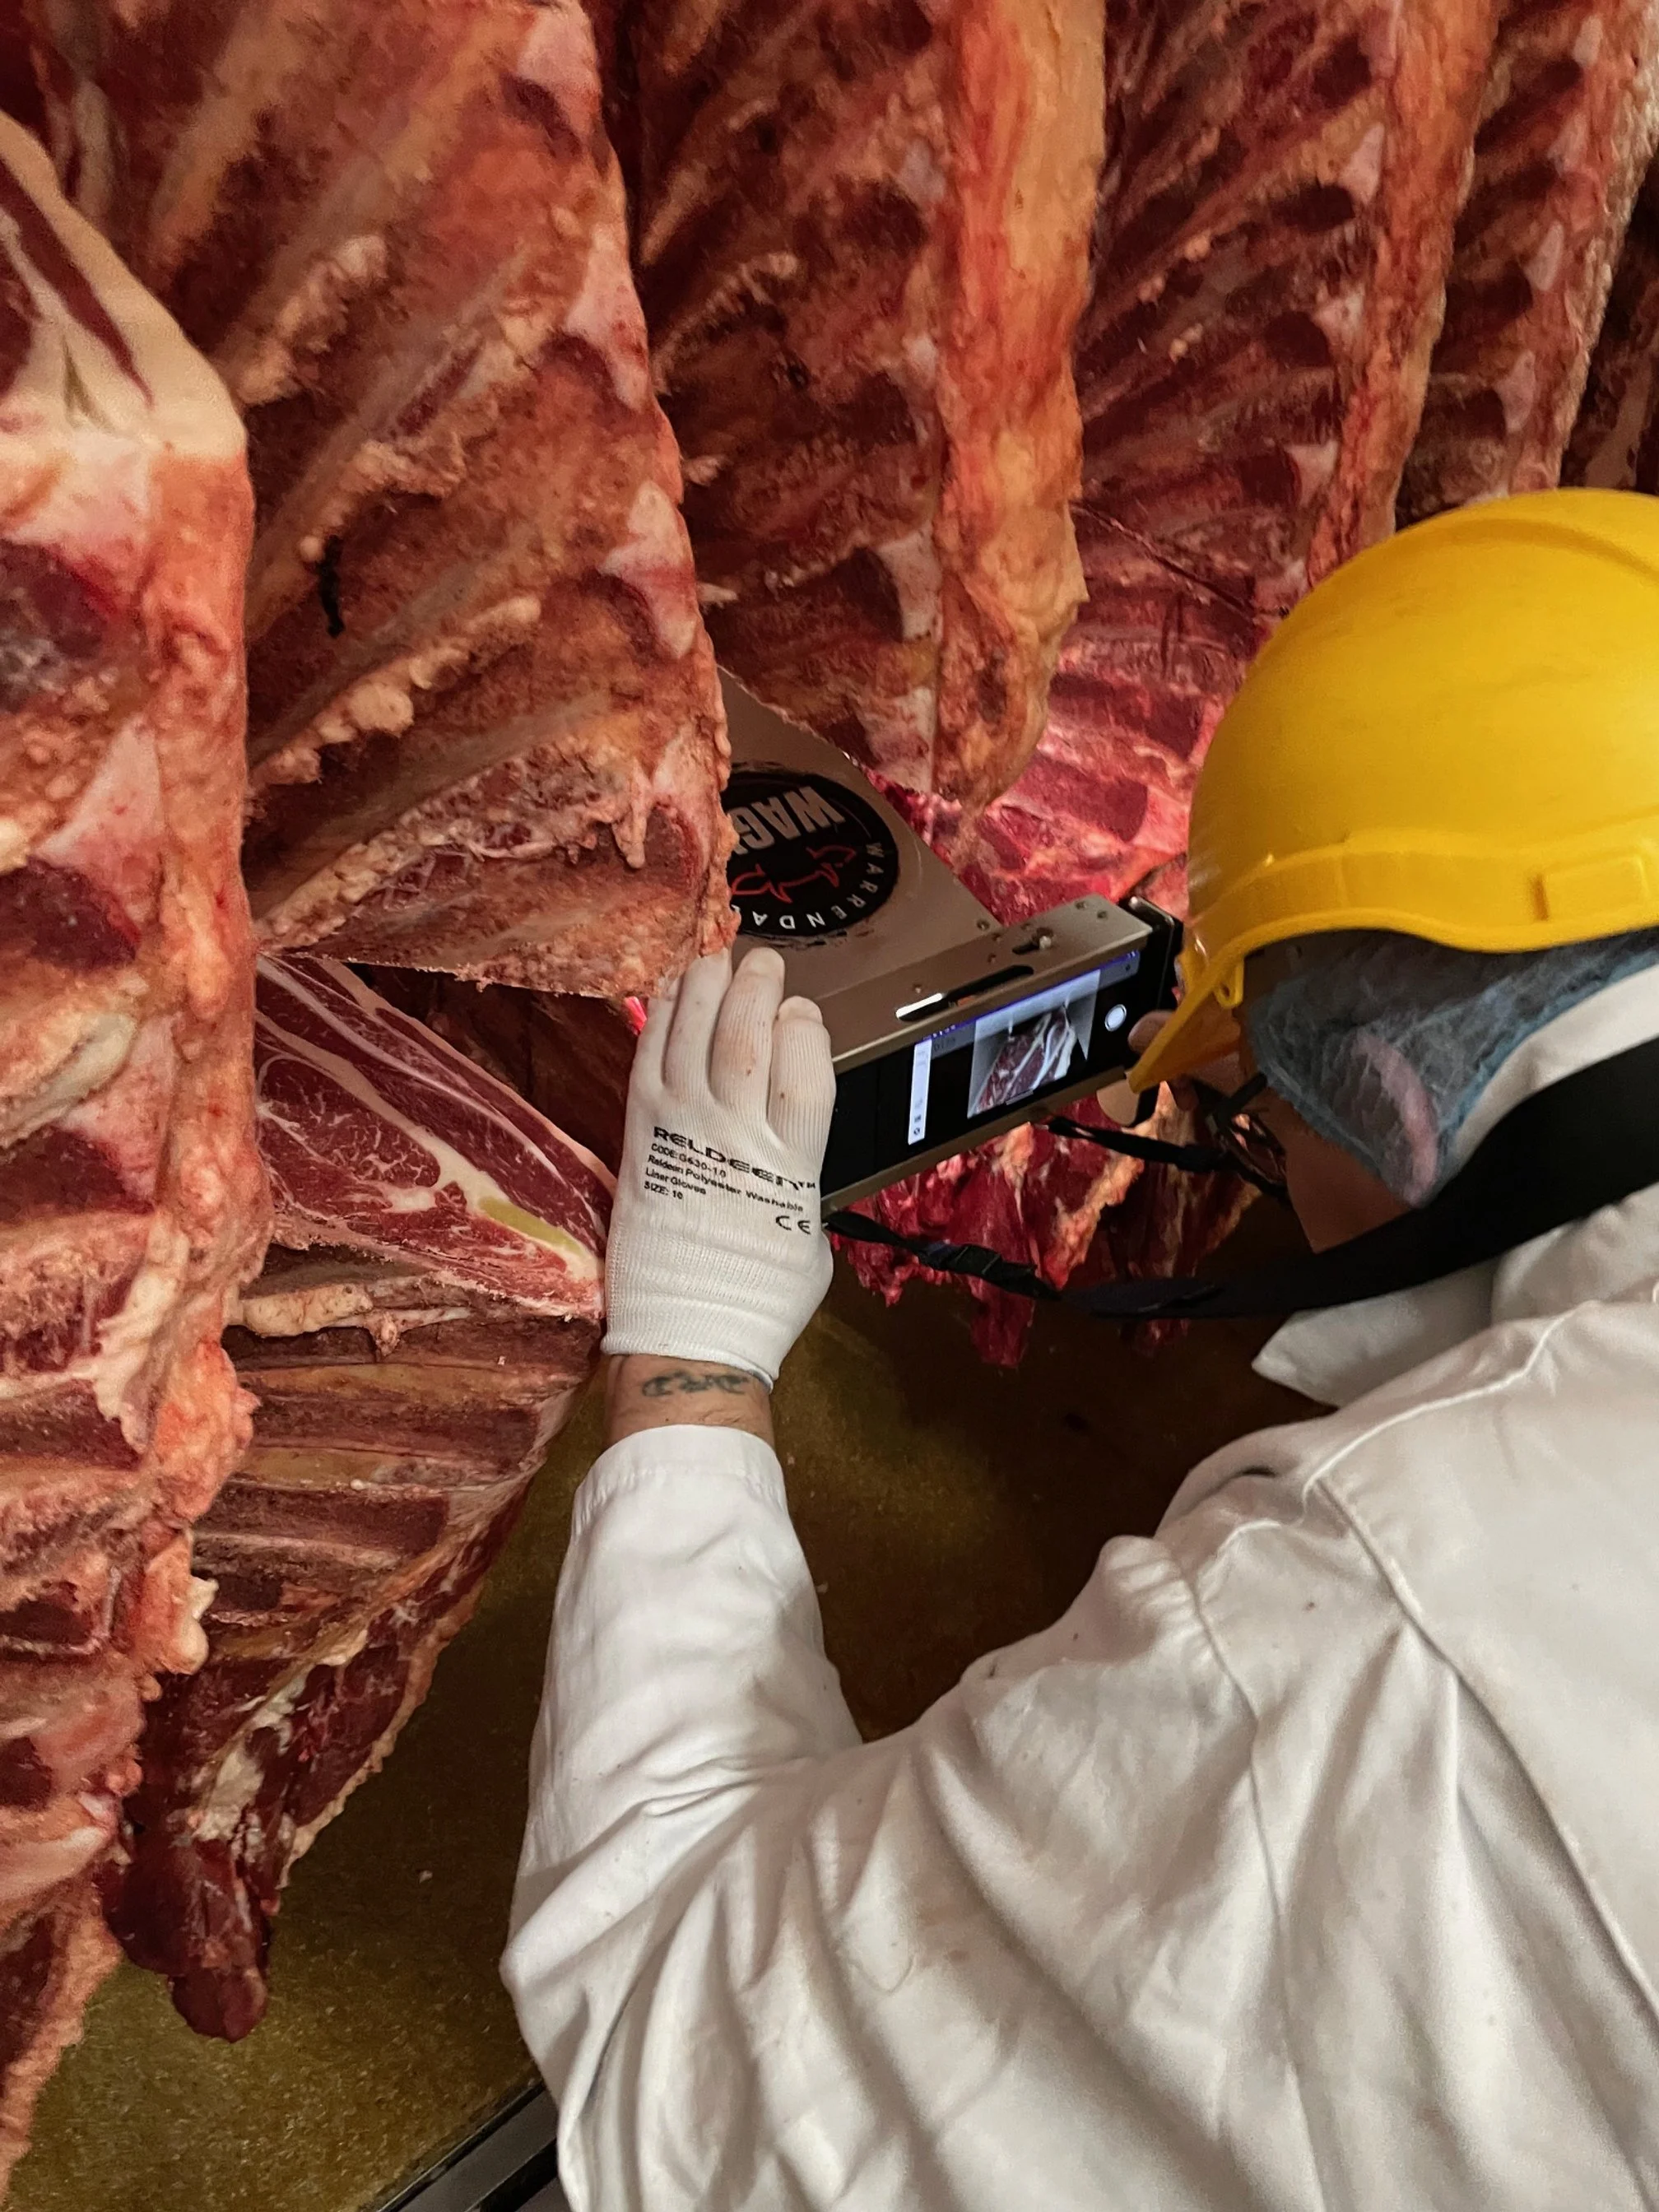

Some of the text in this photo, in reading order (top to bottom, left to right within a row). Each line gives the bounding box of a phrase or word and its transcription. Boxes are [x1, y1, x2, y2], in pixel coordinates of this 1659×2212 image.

[727, 786, 846, 856] WAG
[644, 1180, 684, 1200] SIZE: 10
[646, 1167, 707, 1195] Liner Gloves
[685, 1168, 741, 1195] Polyester
[746, 1190, 804, 1212] Washable
